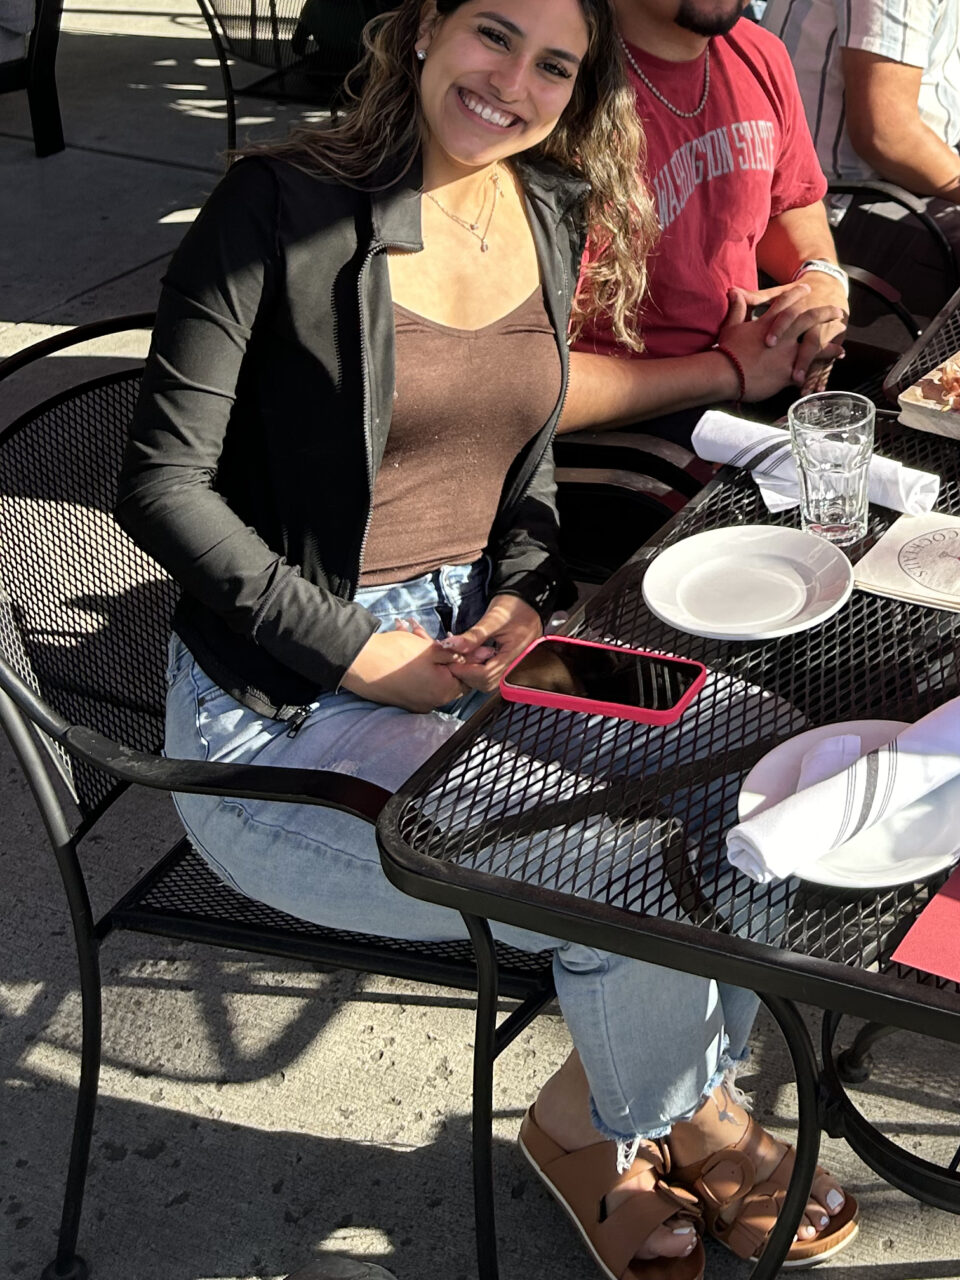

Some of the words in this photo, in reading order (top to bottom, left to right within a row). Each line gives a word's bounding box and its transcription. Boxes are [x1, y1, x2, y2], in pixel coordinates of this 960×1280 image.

[654, 126, 735, 231] WASHINGTON
[731, 120, 775, 174] STATE
[903, 530, 959, 578] COCKTAILS
